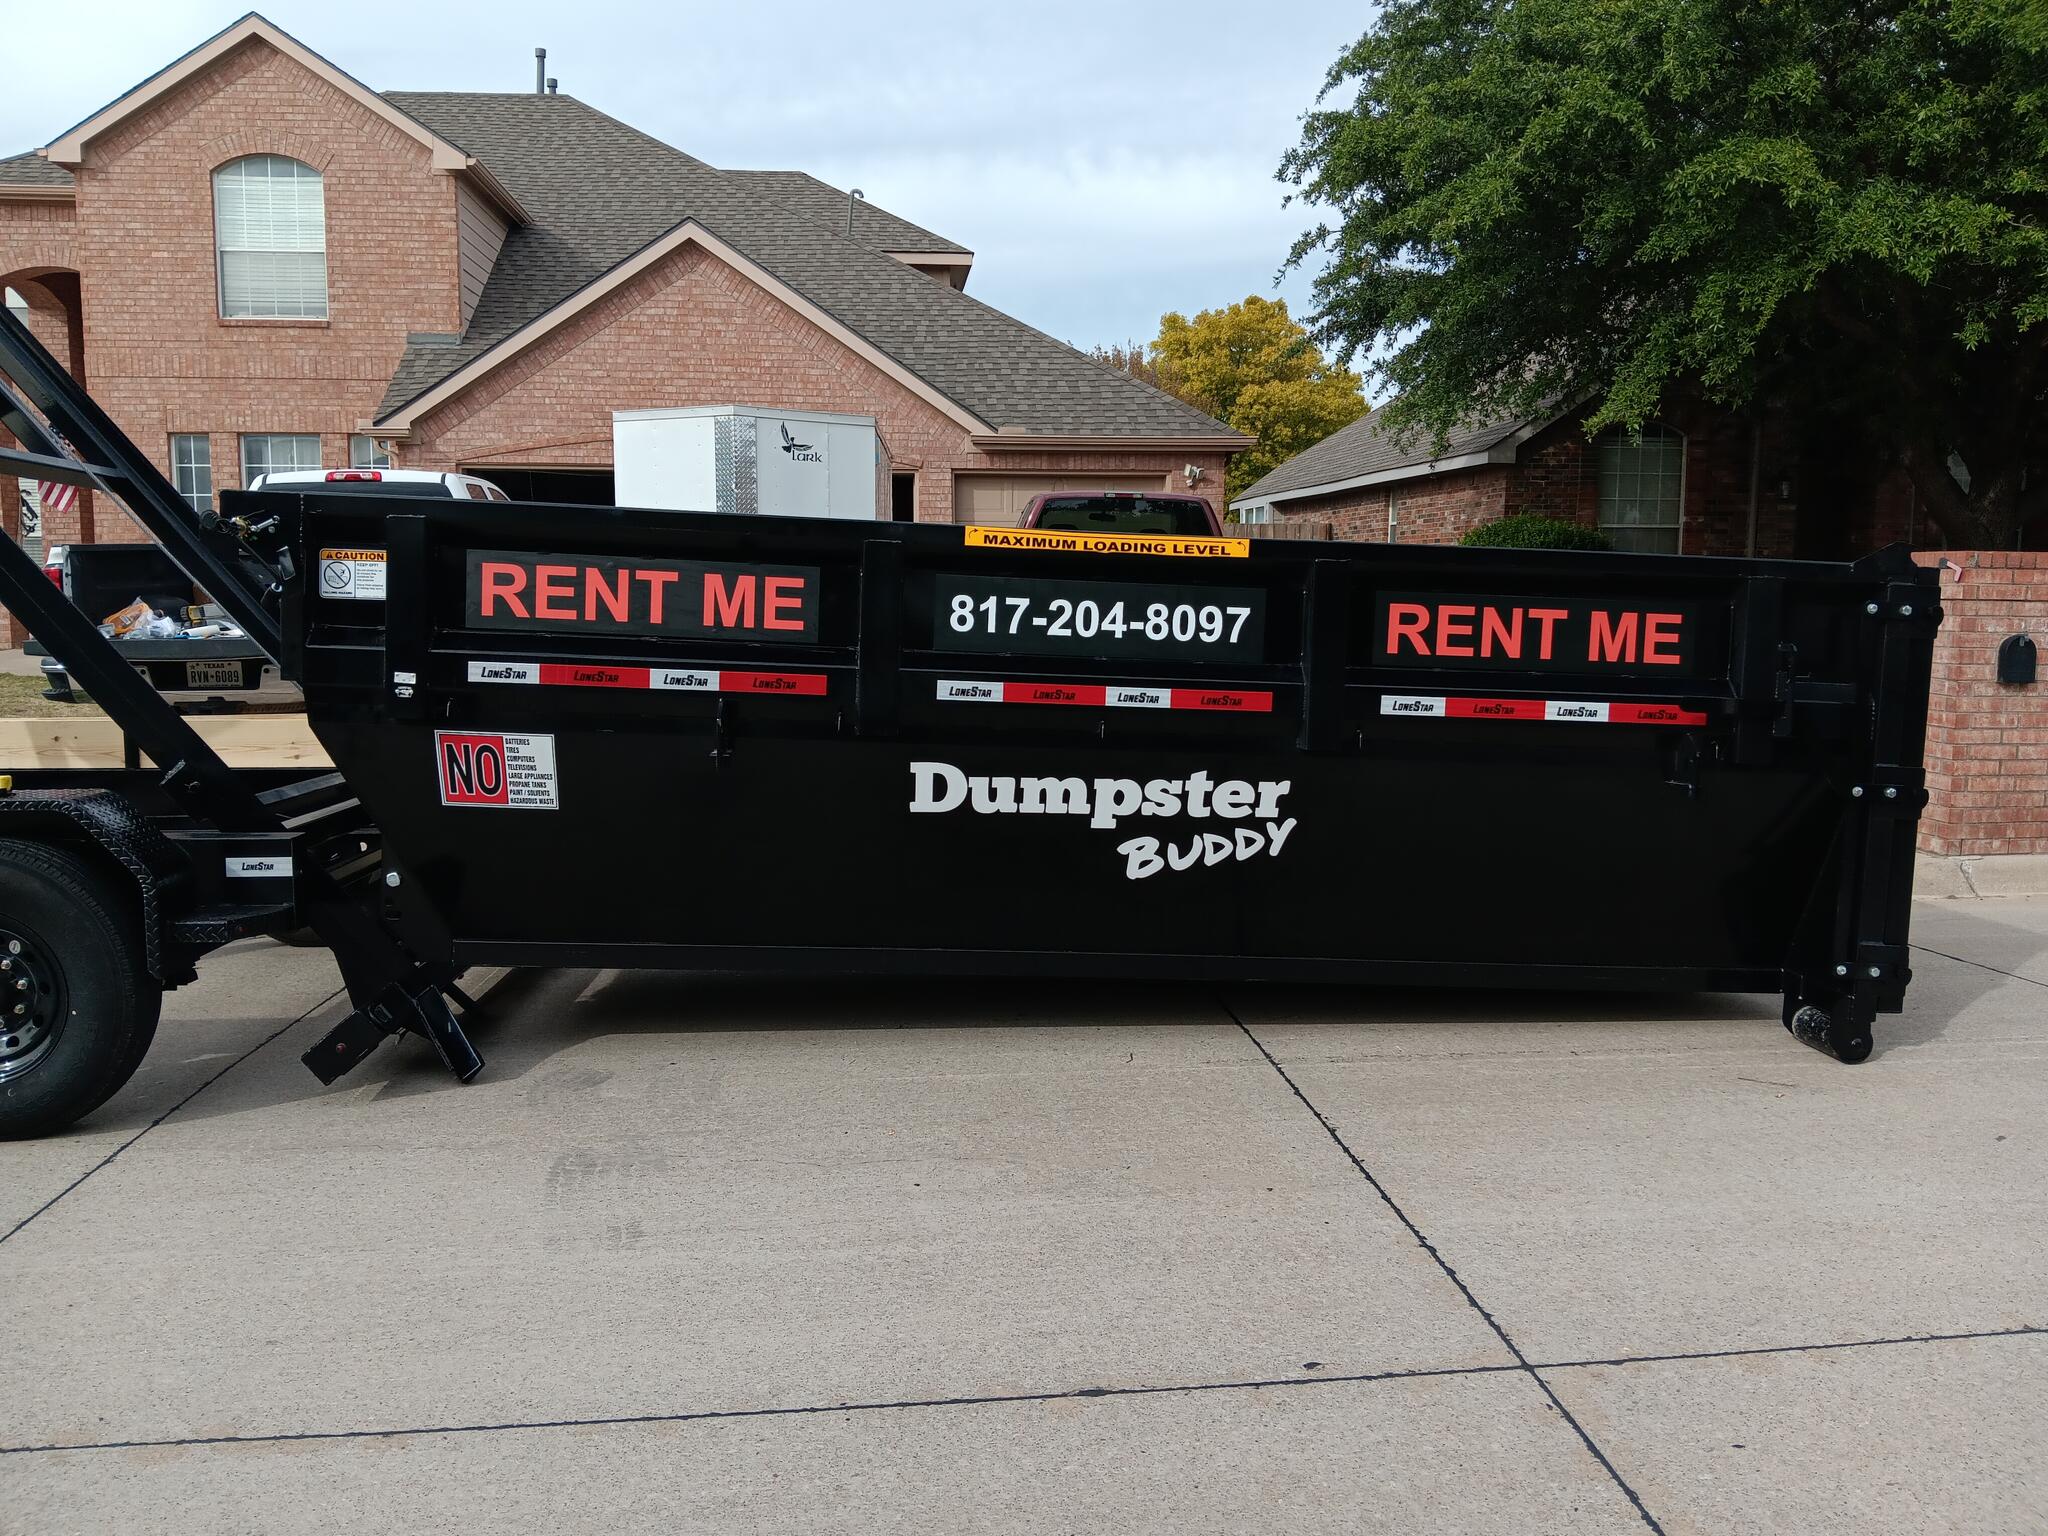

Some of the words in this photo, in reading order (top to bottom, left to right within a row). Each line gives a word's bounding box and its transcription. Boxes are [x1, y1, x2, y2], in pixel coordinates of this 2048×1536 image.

[335, 552, 384, 560] CAUTION
[983, 533, 1076, 550] MAXIMUM
[1083, 540, 1167, 554] LOADING
[1173, 543, 1231, 556] LEVEL
[481, 562, 679, 625] RENT
[703, 573, 805, 631] ME
[950, 594, 1251, 643] 817-204-8097
[1387, 603, 1568, 660] RENT
[1588, 611, 1683, 664] ME
[505, 738, 530, 746] BATTERIES
[444, 743, 503, 797] NO
[508, 764, 537, 772] TELEVISIONS
[524, 773, 553, 781] APPLIANCES
[909, 762, 1291, 829] Dumpster
[1116, 817, 1297, 880] BUDDY
